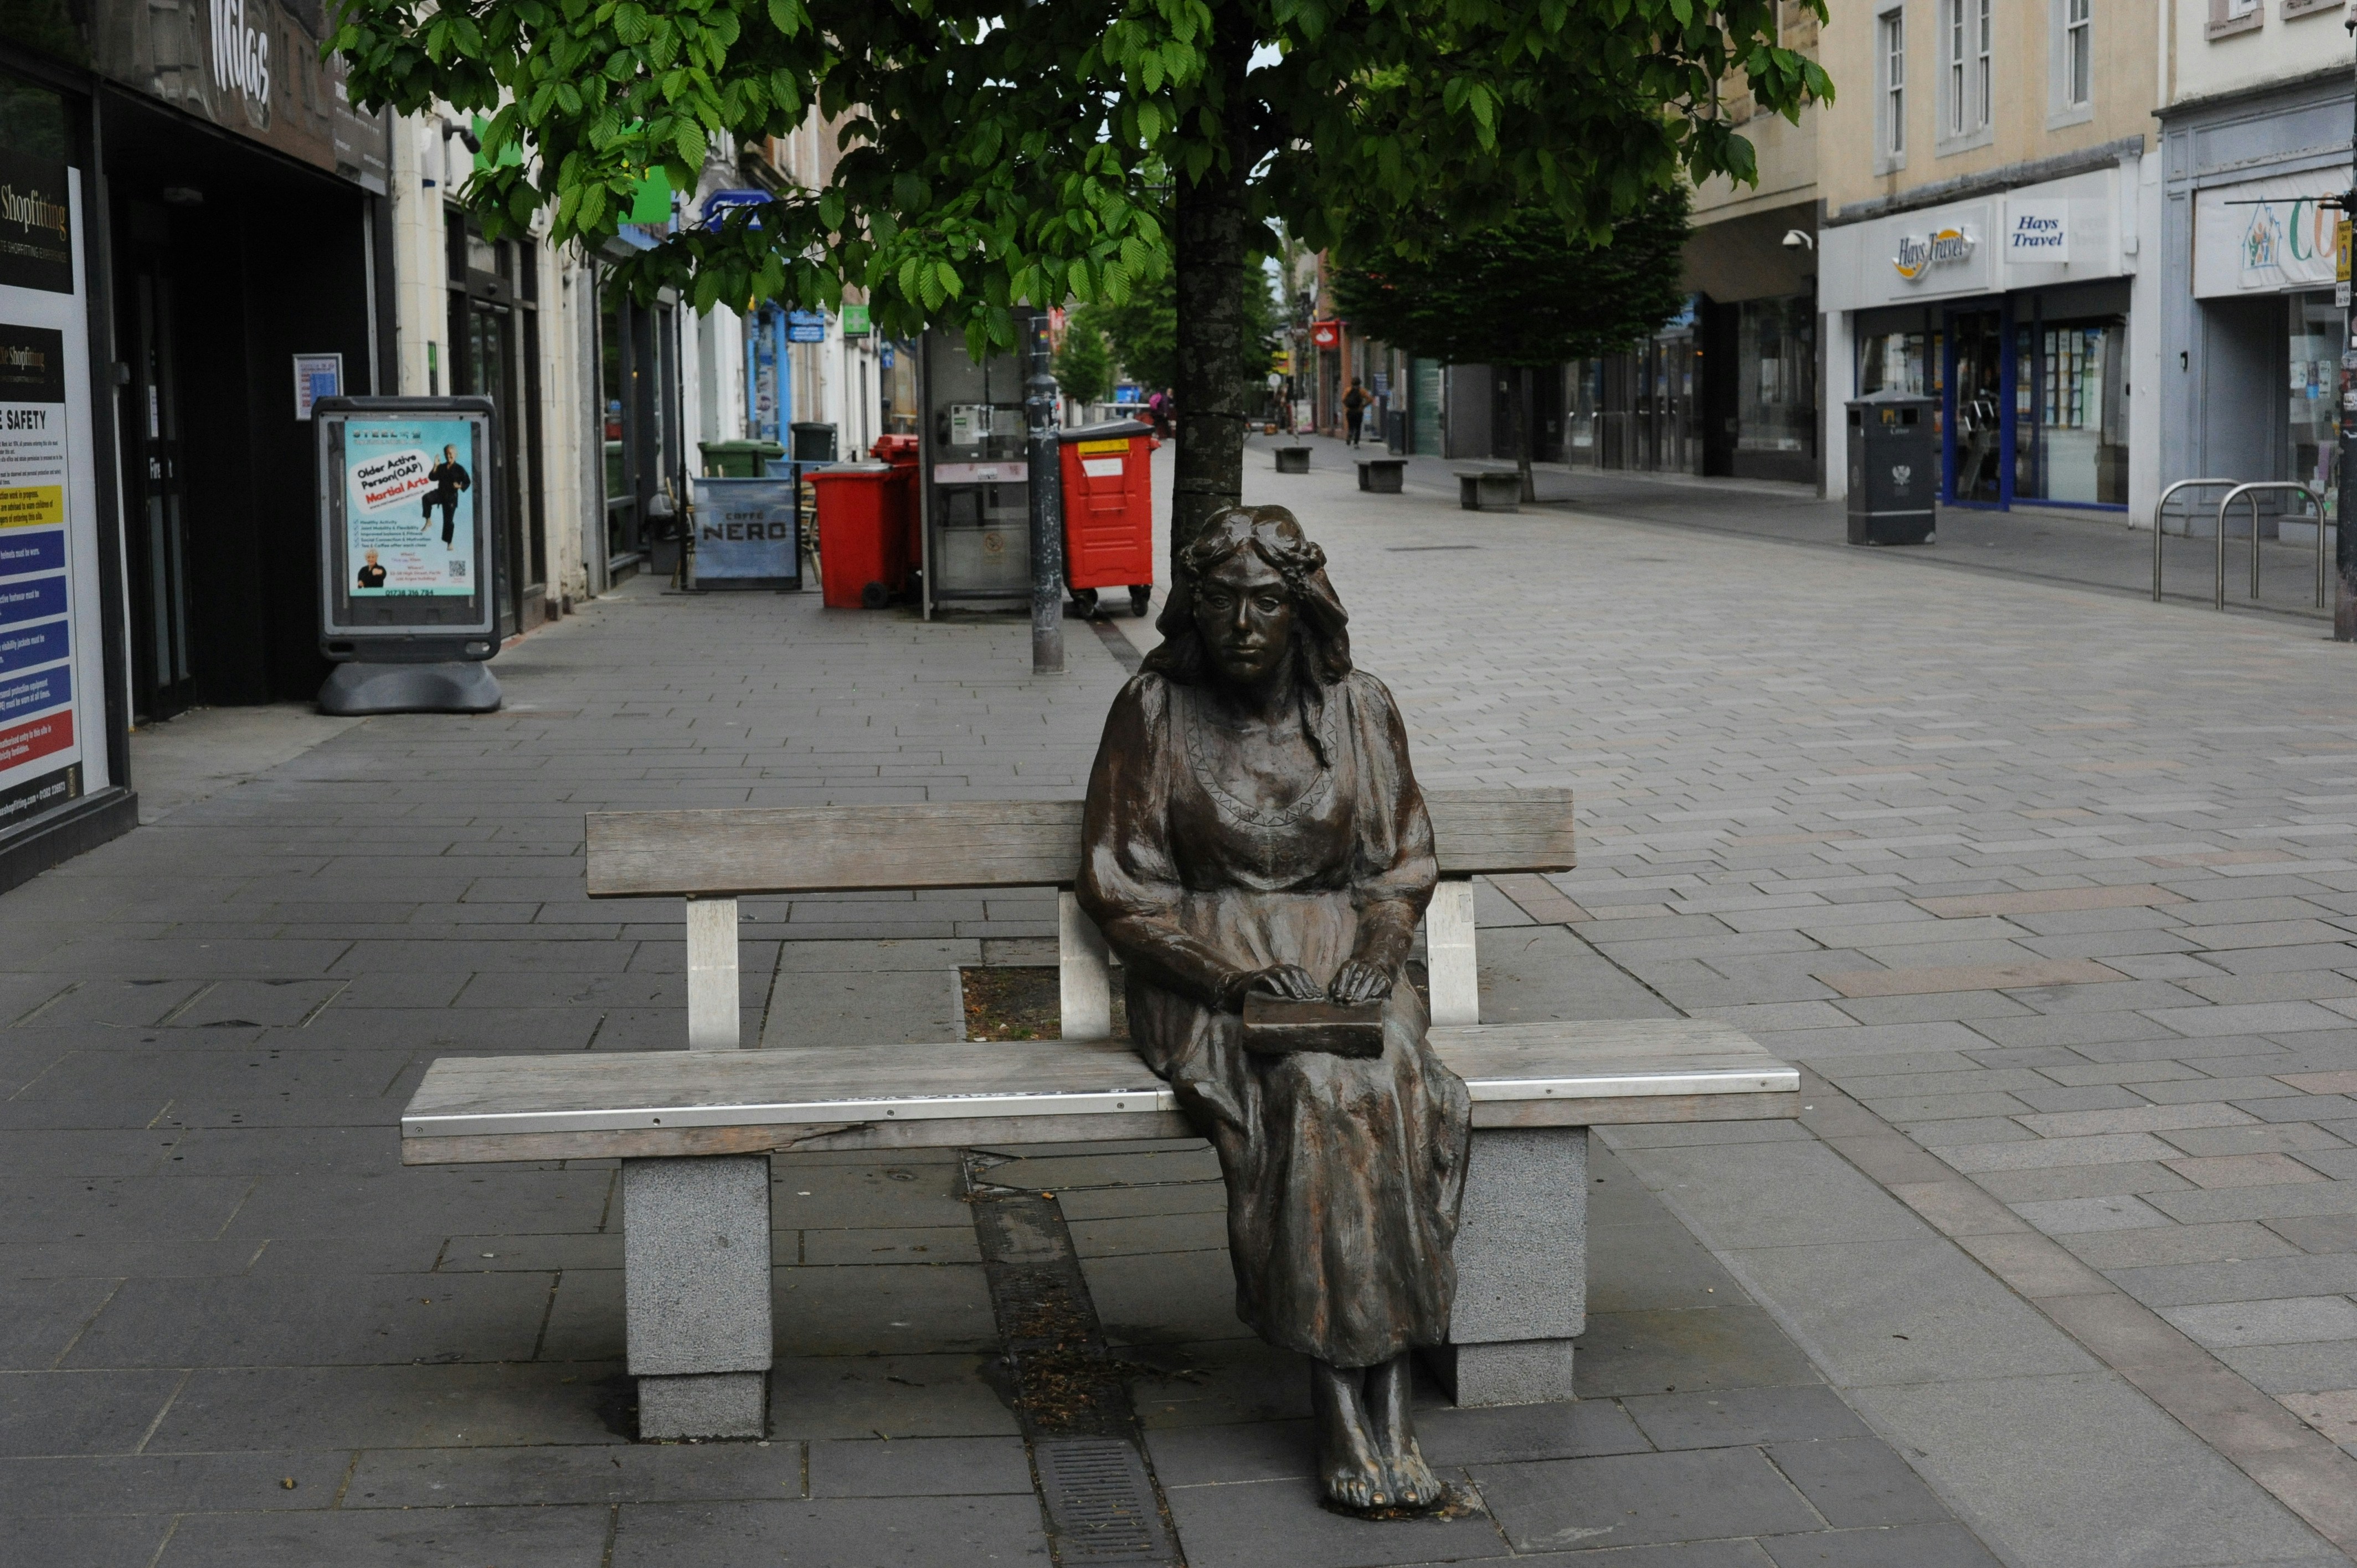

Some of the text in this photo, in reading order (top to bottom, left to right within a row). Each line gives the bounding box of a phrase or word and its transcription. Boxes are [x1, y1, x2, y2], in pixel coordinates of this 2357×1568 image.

[1, 184, 66, 241] Shopfitting
[2016, 215, 2059, 233] Hays
[2012, 232, 2063, 247] Travel
[8, 241, 39, 259] SHOPFITTING
[1898, 227, 1964, 271] Hays Travel
[9, 345, 45, 372] Shopfitting
[7, 410, 46, 430] SAFETY
[358, 455, 417, 478] Older Active
[361, 462, 423, 490] Person(OAP)
[9, 490, 18, 499] work
[19, 489, 23, 498] in
[23, 491, 39, 501] progress.
[365, 482, 405, 504] Martial
[407, 477, 429, 490] Arts
[8, 502, 22, 510] advised
[35, 499, 49, 509] children
[50, 499, 53, 508] of
[9, 513, 13, 523] of
[13, 513, 28, 524] entering
[703, 522, 786, 540] NERO
[1, 550, 15, 559] helmets
[16, 548, 24, 558] must
[25, 548, 29, 556] be
[9, 592, 25, 602] footwear
[25, 590, 34, 600] must
[35, 589, 40, 598] be
[2, 634, 45, 651] visibility jackets must be
[11, 683, 30, 698] protection
[30, 678, 48, 693] equipment
[6, 698, 16, 709] must
[16, 697, 21, 707] be
[21, 695, 30, 705] worn
[30, 692, 35, 702] at
[40, 690, 51, 700] times.
[19, 731, 29, 742] entry
[29, 729, 33, 739] to
[48, 724, 52, 733] is
[11, 744, 30, 757] forbidden.
